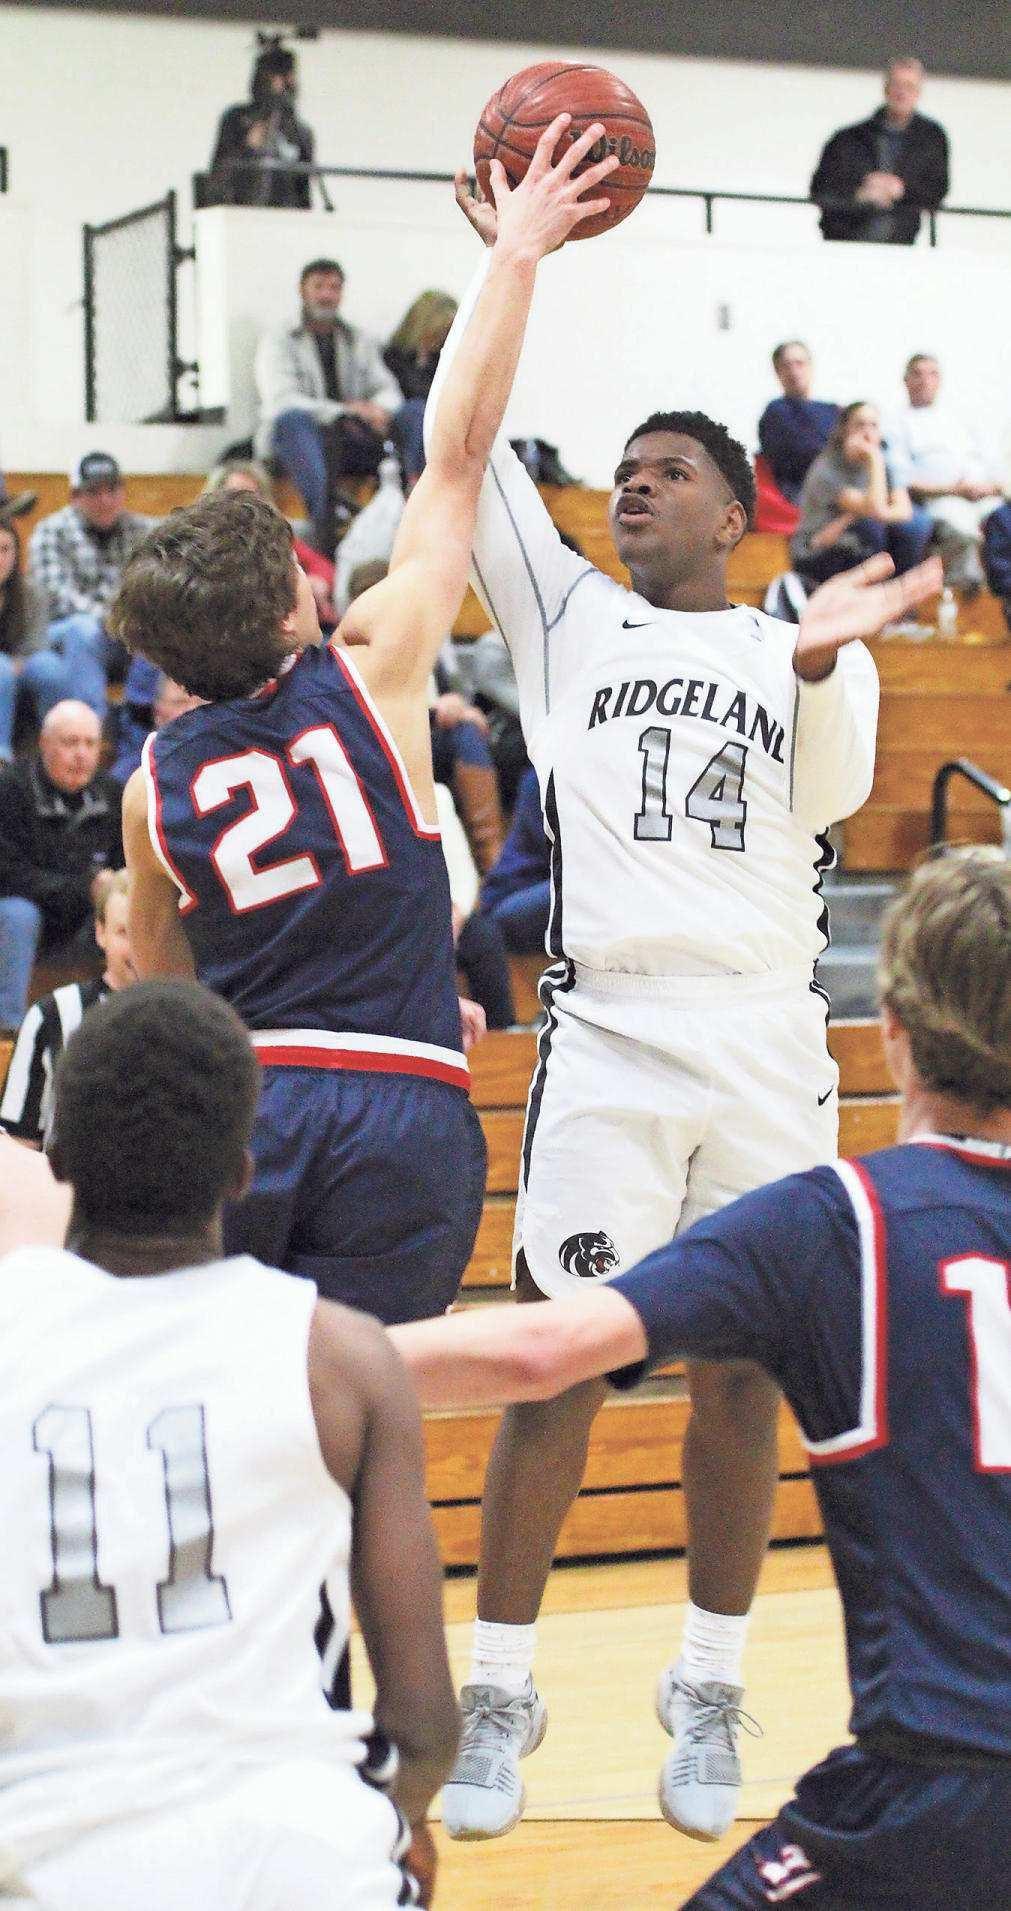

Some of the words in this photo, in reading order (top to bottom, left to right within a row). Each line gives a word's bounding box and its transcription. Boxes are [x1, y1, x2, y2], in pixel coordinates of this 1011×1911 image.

[189, 722, 389, 914] 21
[634, 726, 749, 852] 14
[32, 1401, 232, 1644] 11
